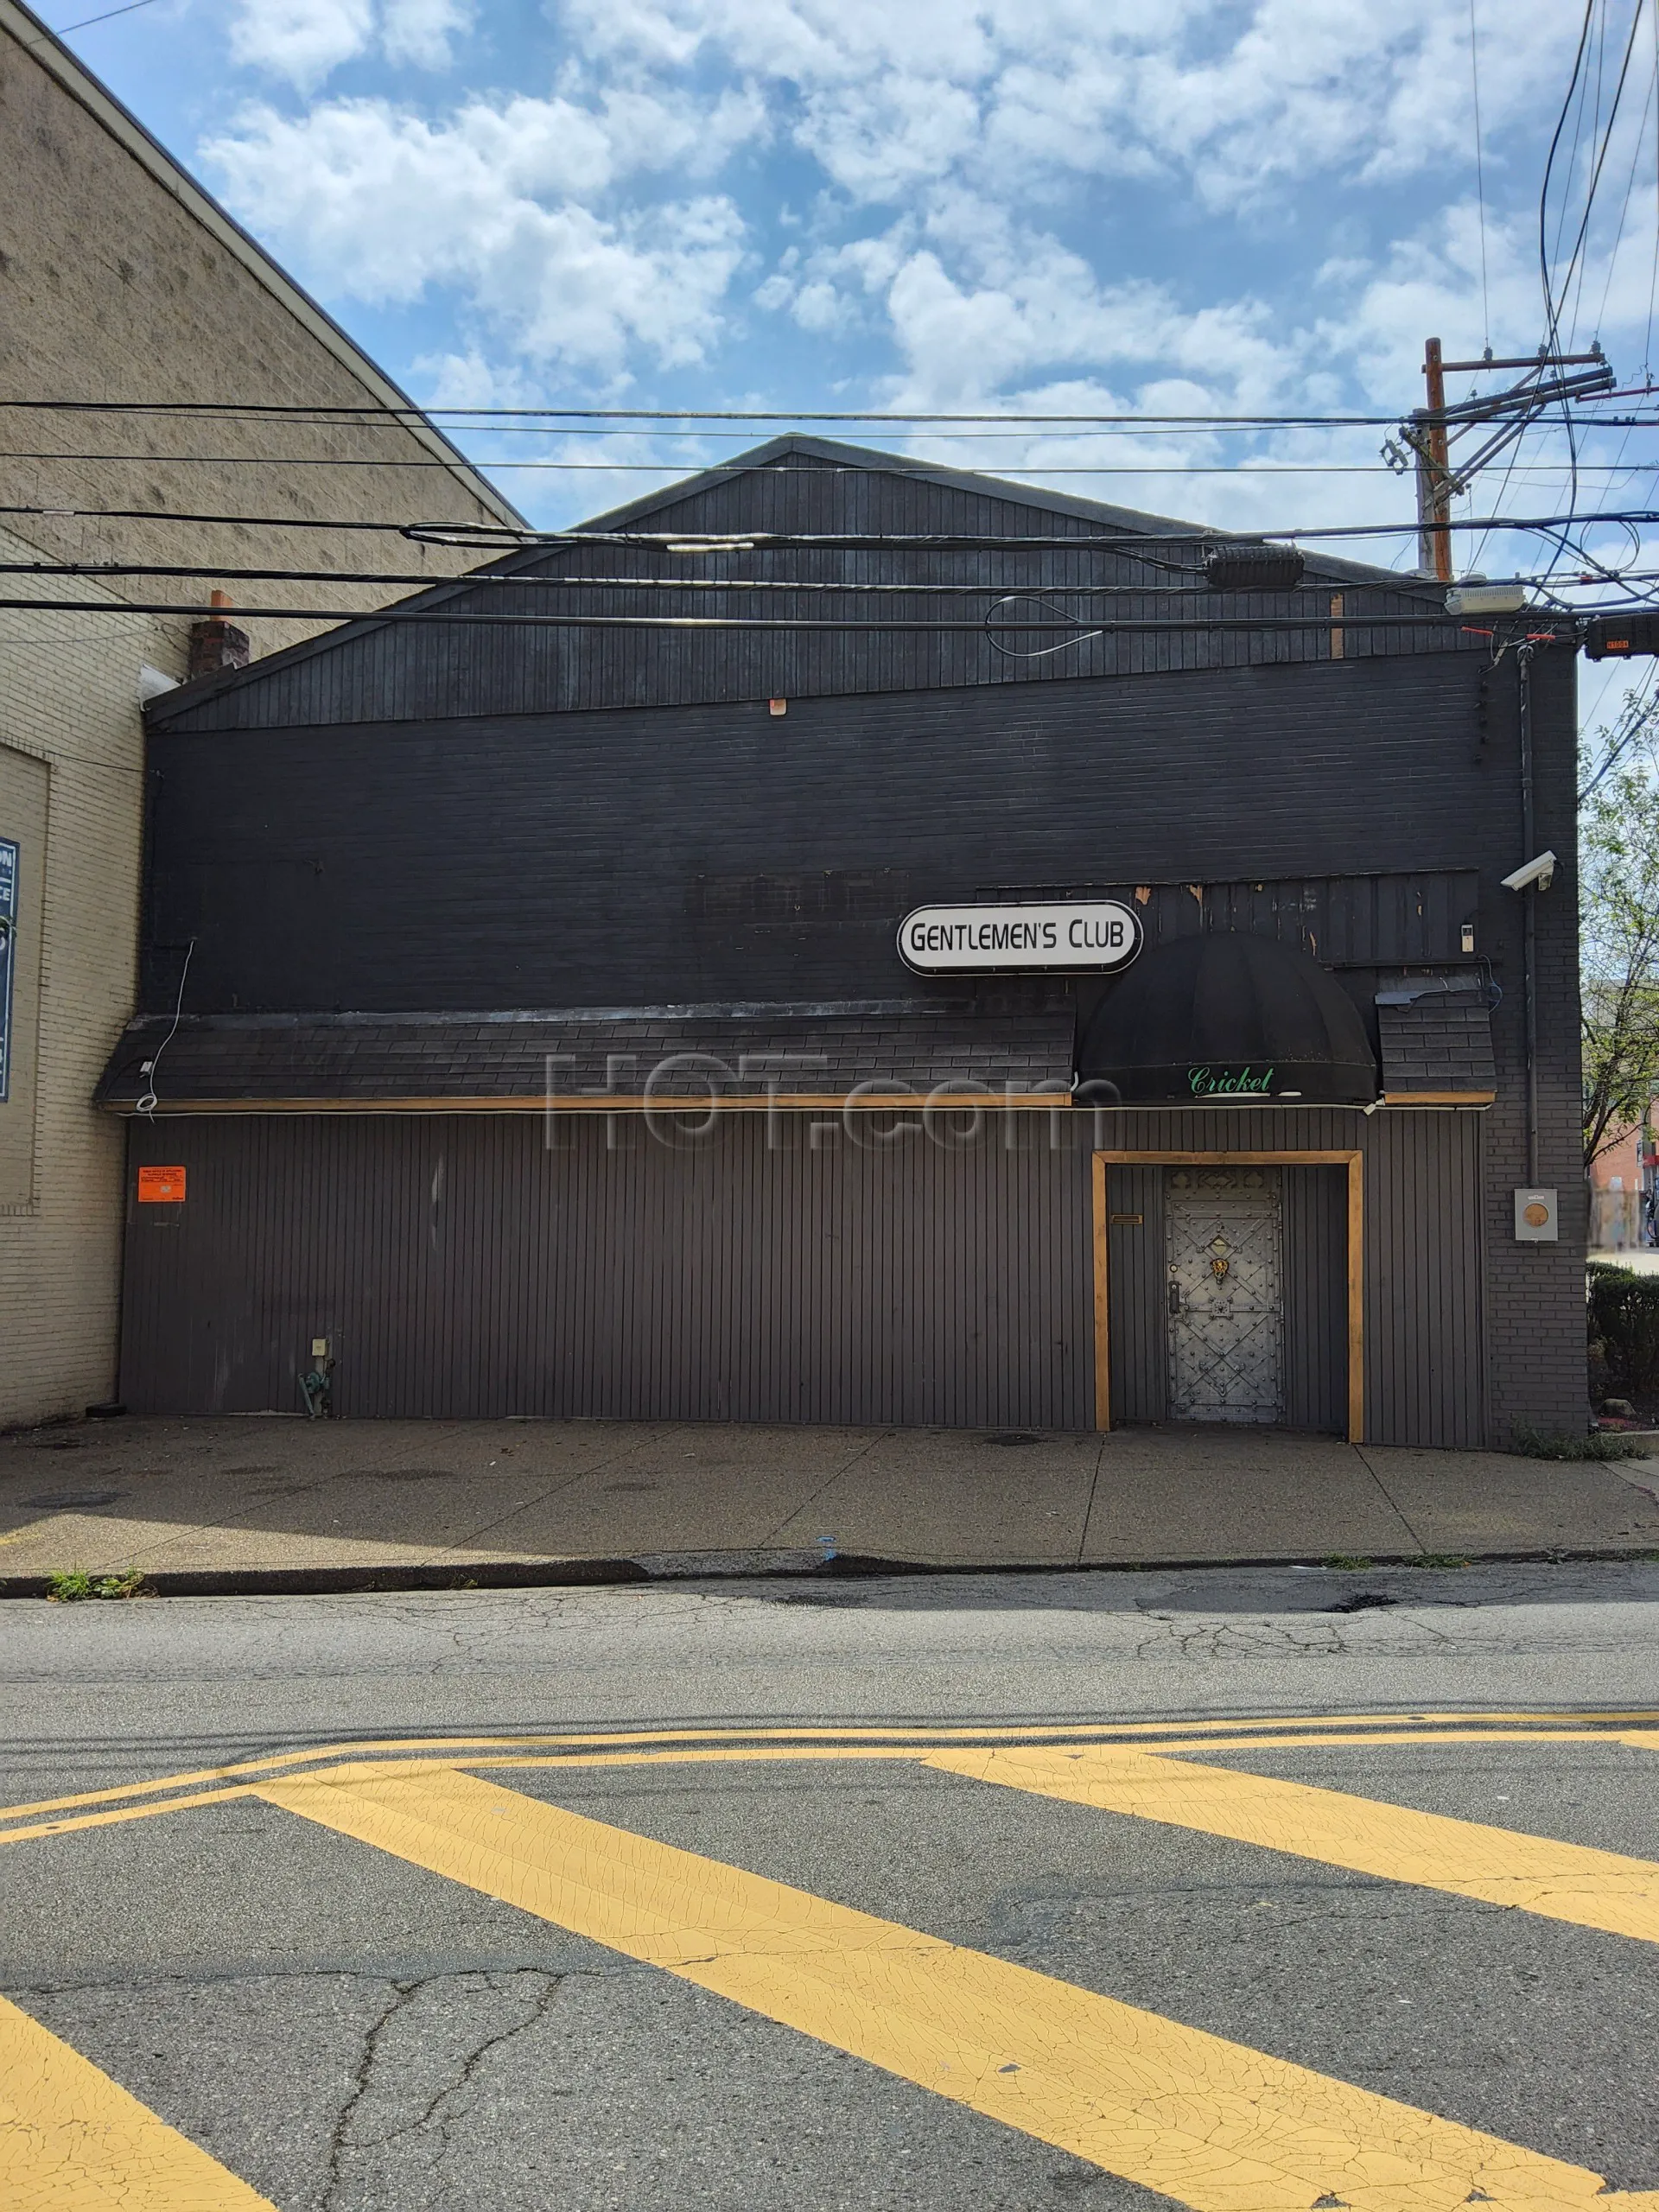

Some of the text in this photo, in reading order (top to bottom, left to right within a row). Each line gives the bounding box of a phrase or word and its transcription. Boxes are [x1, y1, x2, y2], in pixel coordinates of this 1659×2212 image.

[911, 919, 1124, 950] GENTLEMEN'S CLUB
[1188, 1066, 1274, 1093] Cricket
